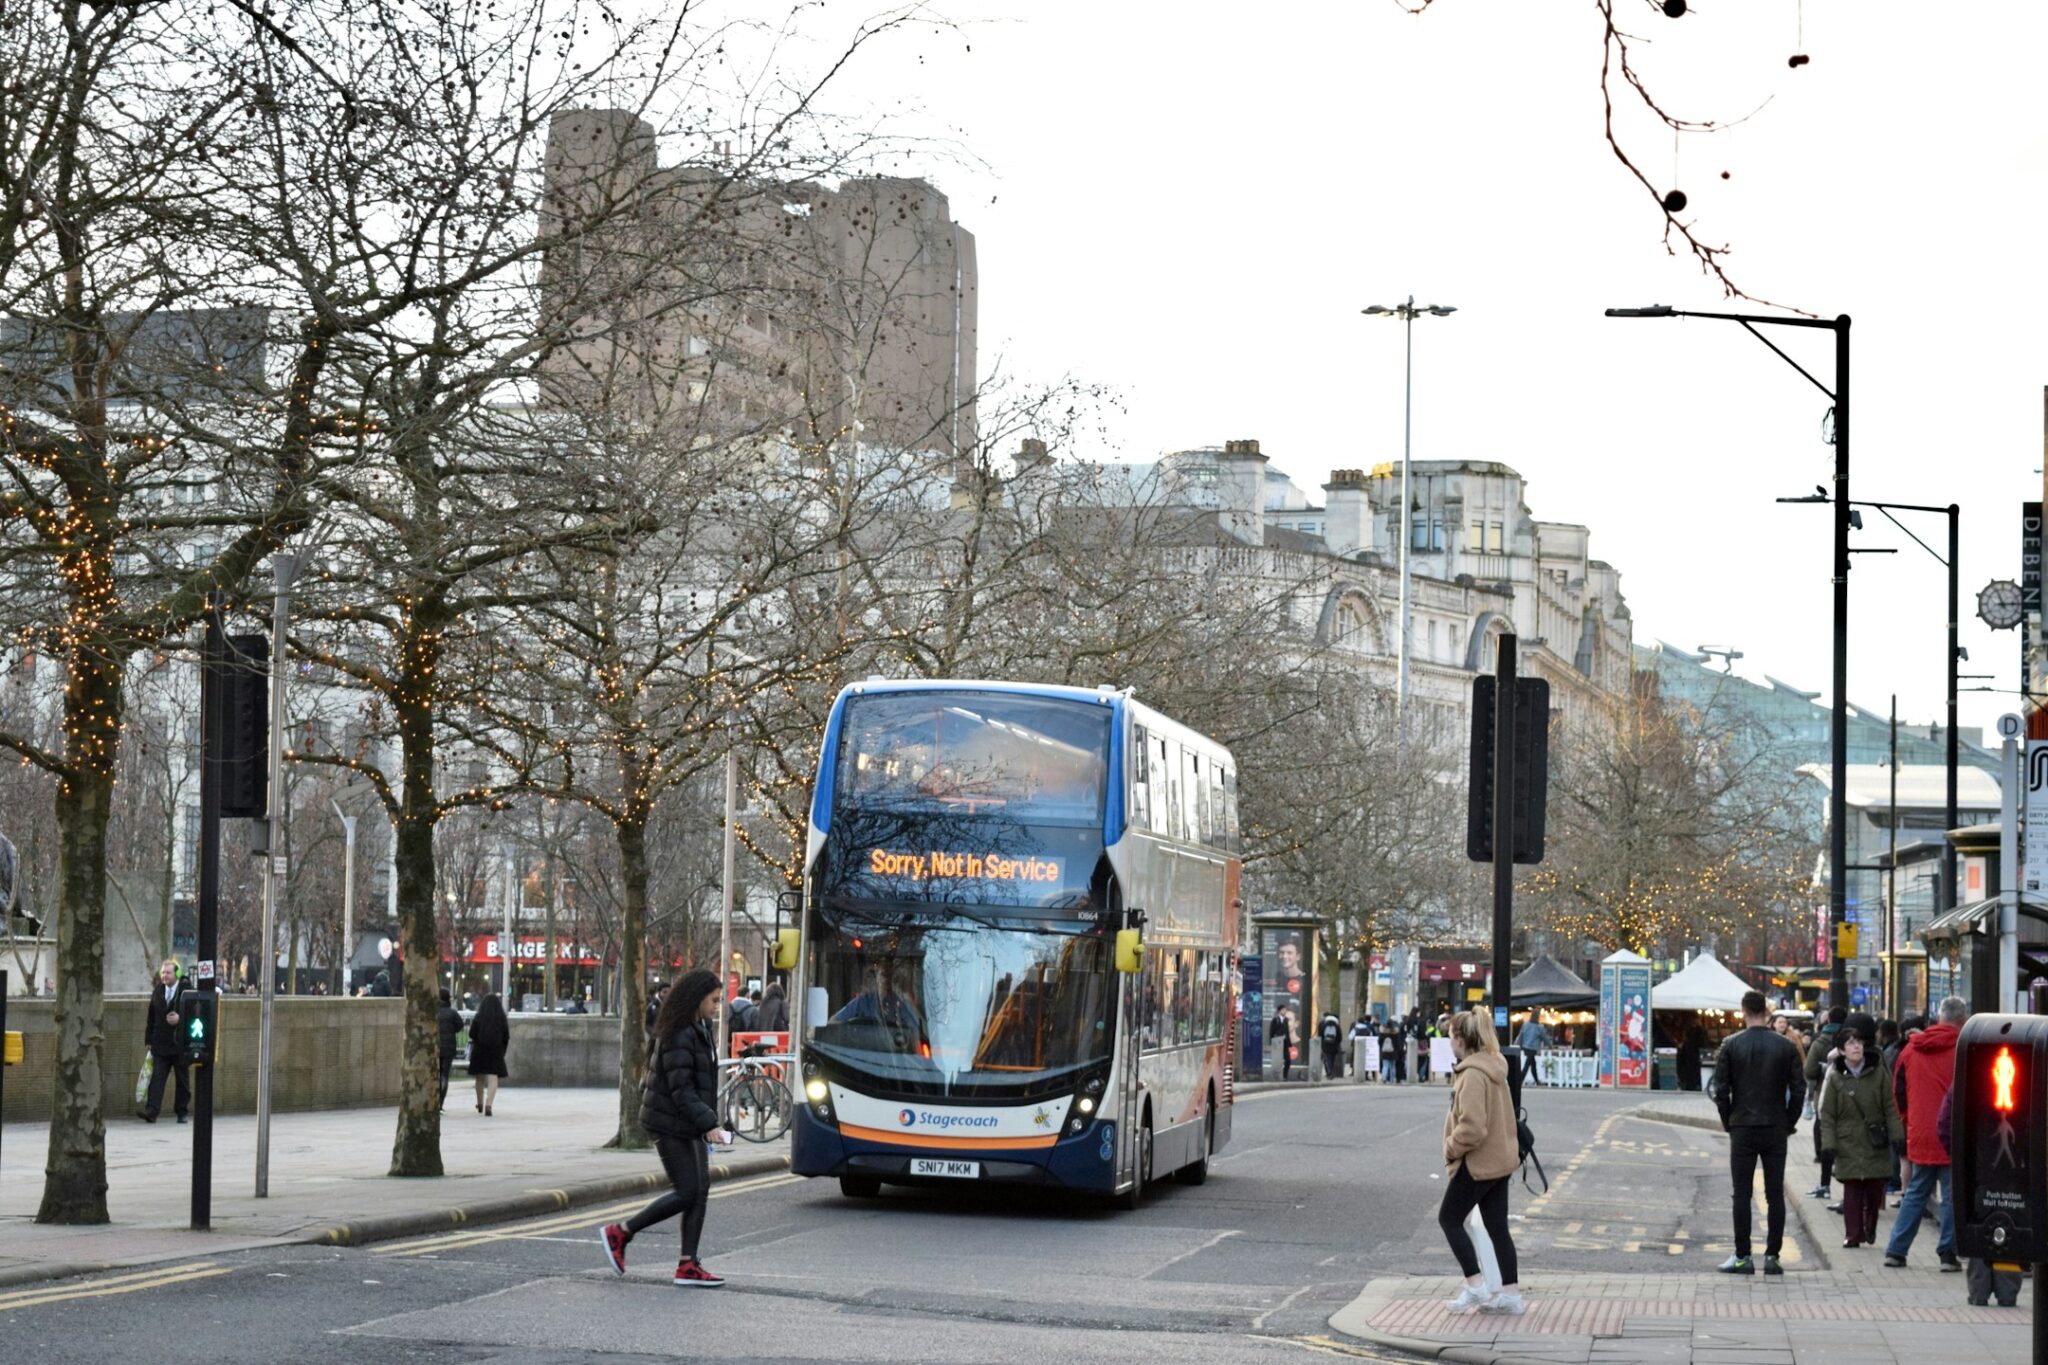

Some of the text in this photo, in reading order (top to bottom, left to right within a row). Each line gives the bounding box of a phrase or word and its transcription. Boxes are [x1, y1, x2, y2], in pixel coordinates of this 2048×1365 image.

[2004, 716, 2018, 736] D
[871, 849, 1059, 881] Sorry, Not In Service
[1078, 911, 1099, 920] 10864
[487, 940, 557, 958] BRGE
[920, 1112, 998, 1128] Stagecoach
[918, 1161, 972, 1175] SN17 MKM
[1986, 1190, 2021, 1200] Push button
[2008, 1201, 2025, 1209] signal
